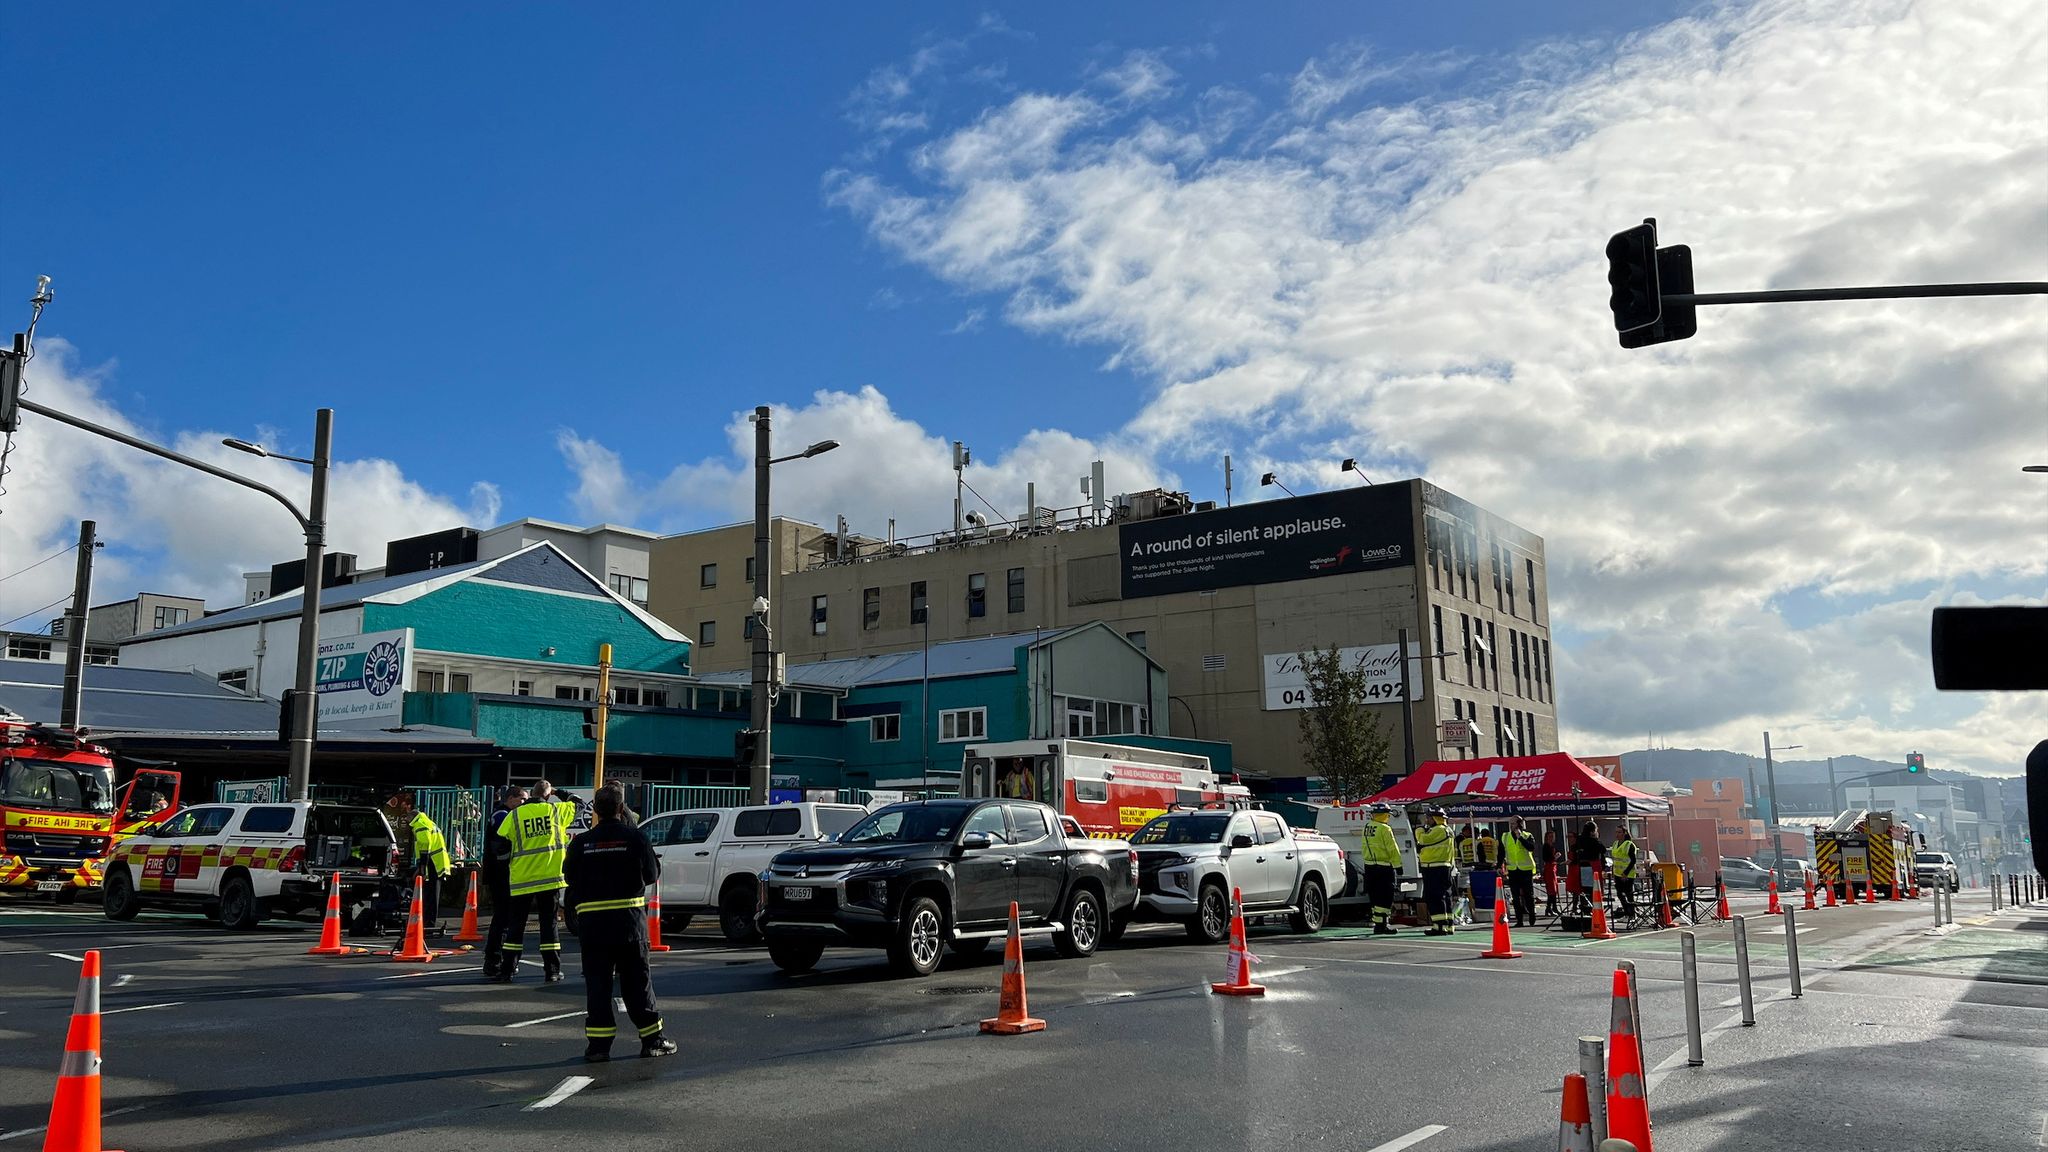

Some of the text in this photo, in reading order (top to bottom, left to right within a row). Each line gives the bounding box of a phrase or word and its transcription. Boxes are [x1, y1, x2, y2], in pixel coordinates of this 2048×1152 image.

[1131, 516, 1346, 557] A round of silent applause.
[1176, 557, 1204, 566] thousands
[1225, 549, 1265, 560] Wellingtonians
[1144, 569, 1171, 578] supported
[1183, 566, 1199, 574] Silent
[317, 641, 355, 656] ipnz.co.nz
[365, 643, 398, 676] PLUMBING
[1354, 648, 1401, 670] Lodg
[320, 656, 347, 681] ZIP
[351, 680, 360, 688] GAS
[370, 677, 391, 694] PLUS
[1282, 689, 1306, 705] 04
[350, 703, 368, 715] keep
[1426, 764, 1509, 794] rrt
[1511, 768, 1547, 778] RAPID
[1508, 775, 1545, 785] RELIEF
[1506, 783, 1541, 792] TEAM
[28, 816, 70, 827] FIRE AHI
[1344, 809, 1365, 821] rrt
[523, 815, 552, 834] FIRE
[525, 830, 553, 839] RESCUE
[145, 858, 164, 869] FIRE
